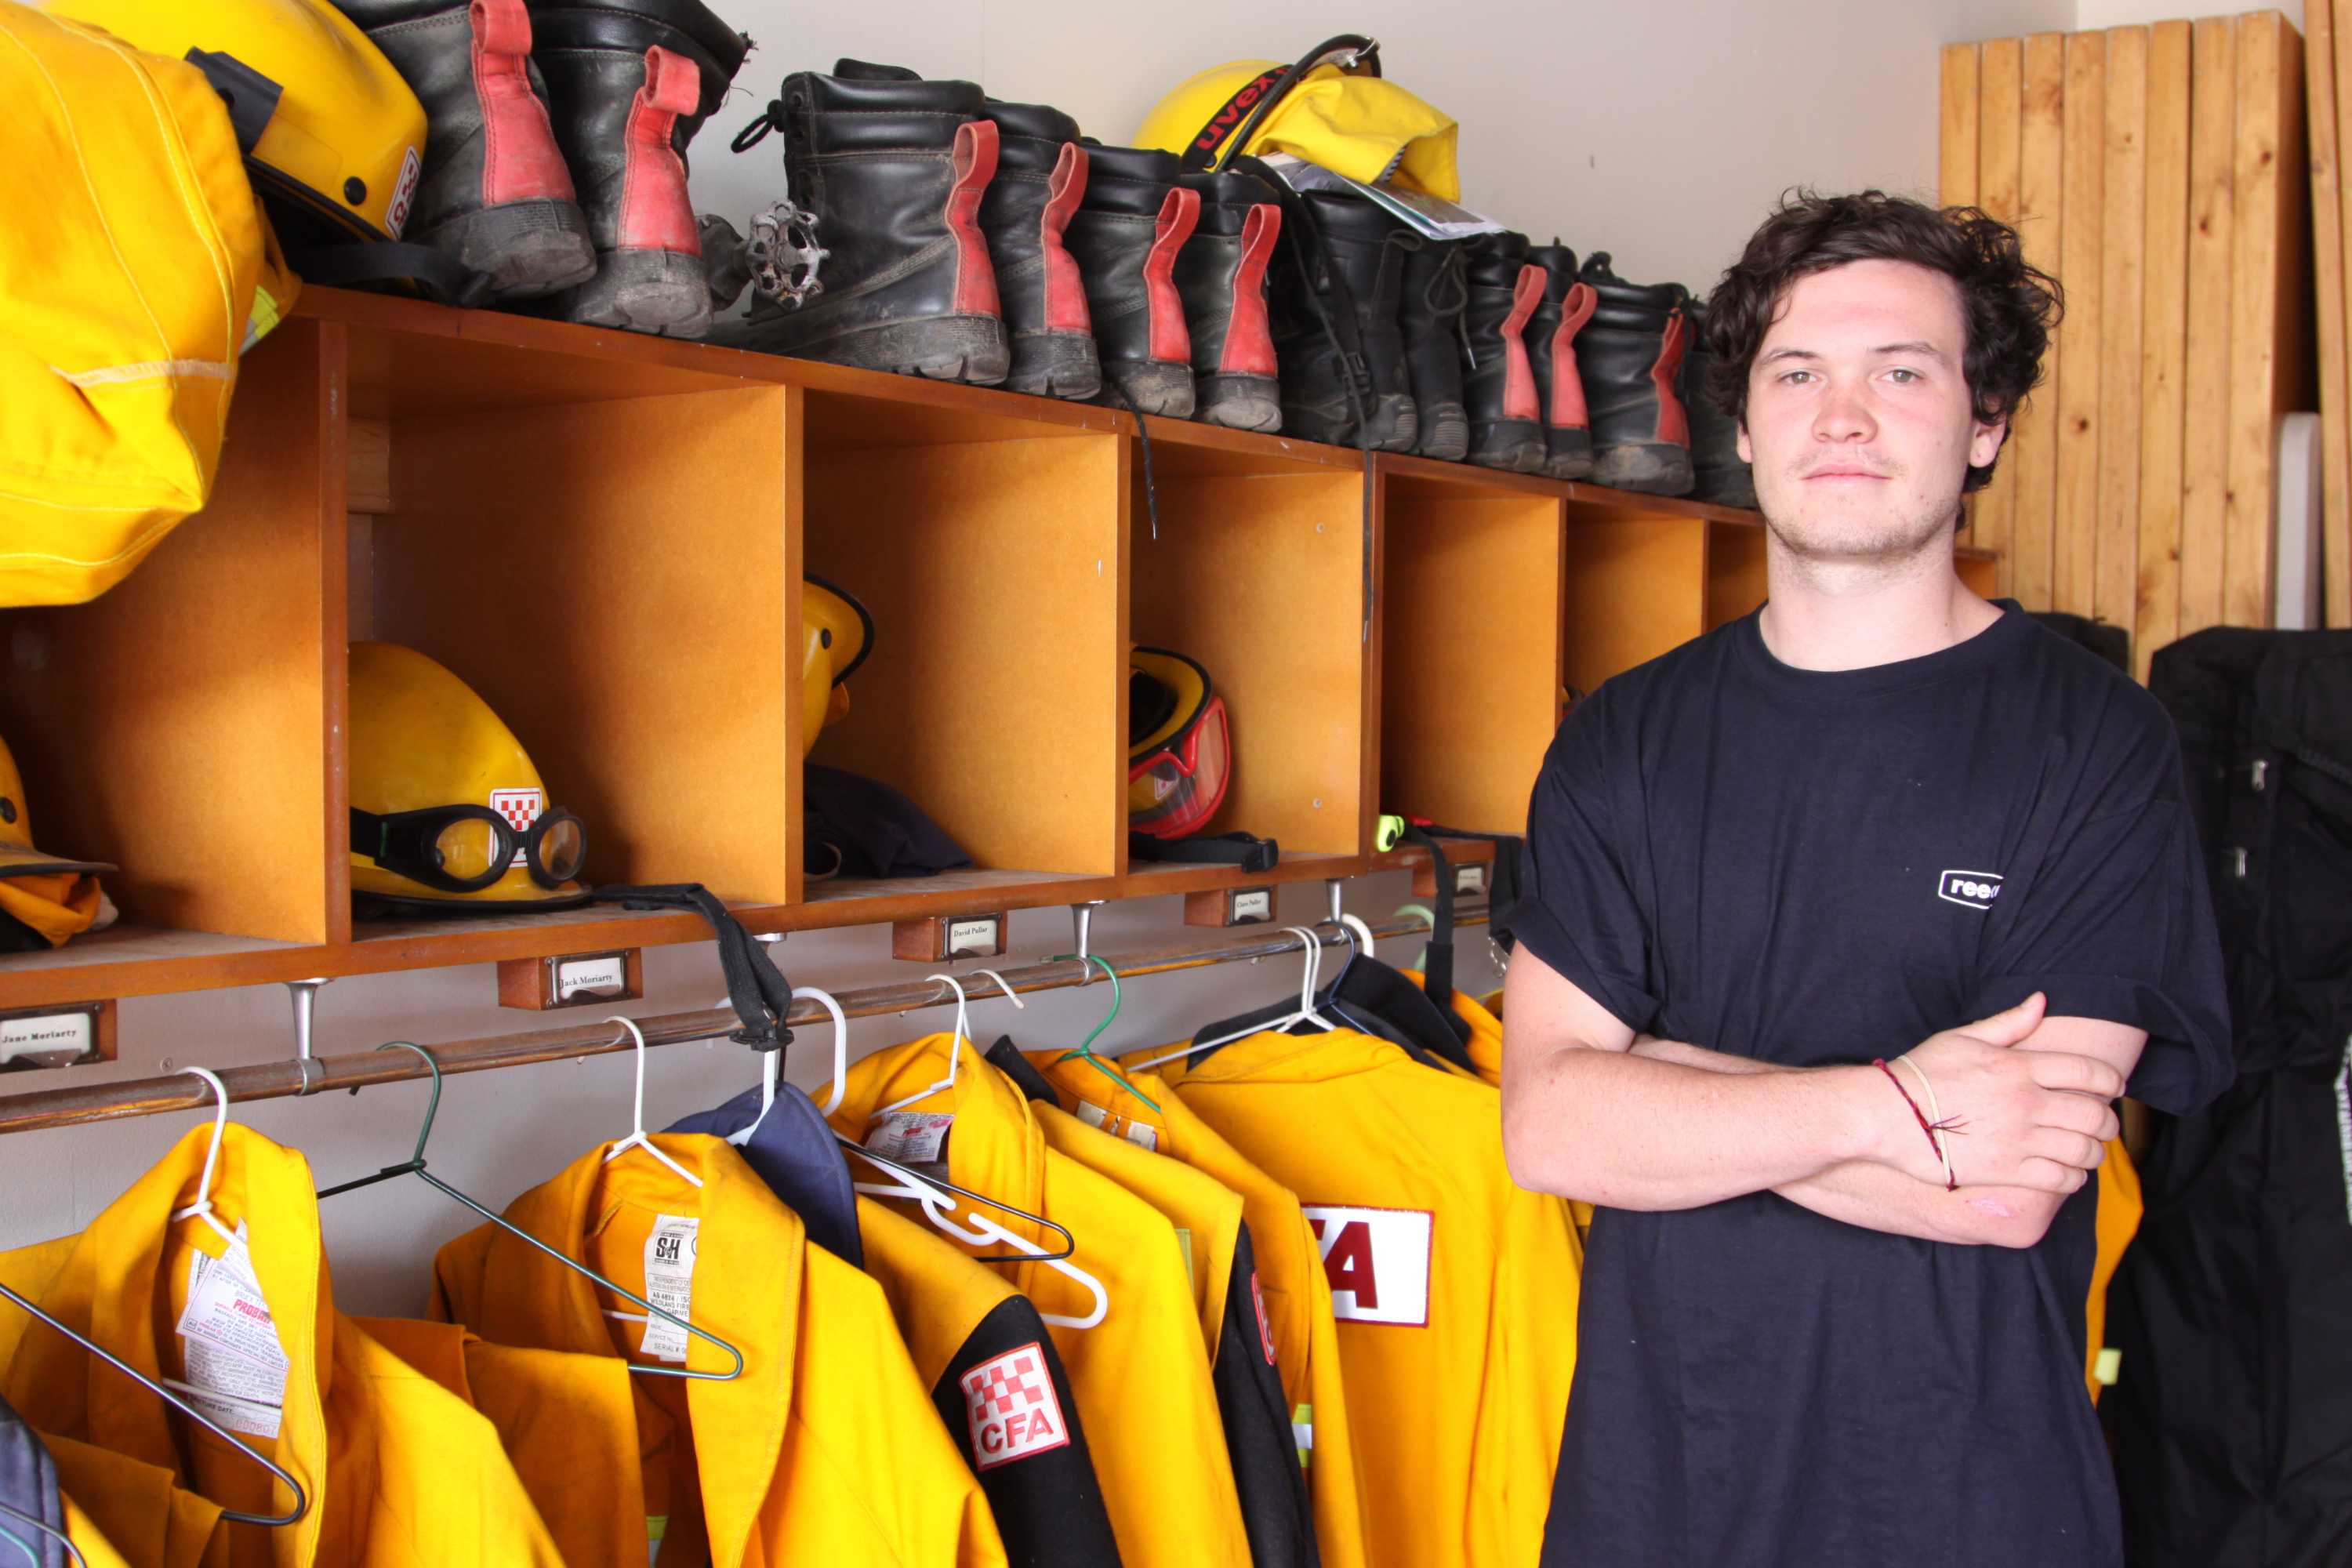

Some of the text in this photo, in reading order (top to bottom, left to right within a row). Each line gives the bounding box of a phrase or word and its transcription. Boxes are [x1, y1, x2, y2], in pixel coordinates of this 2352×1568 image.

[1196, 76, 1276, 150] uvex
[953, 928, 971, 937] David
[559, 975, 612, 989] Jack Moriarty
[2, 1029, 77, 1044] Jane Moriarty
[981, 1408, 1054, 1454] CFA
